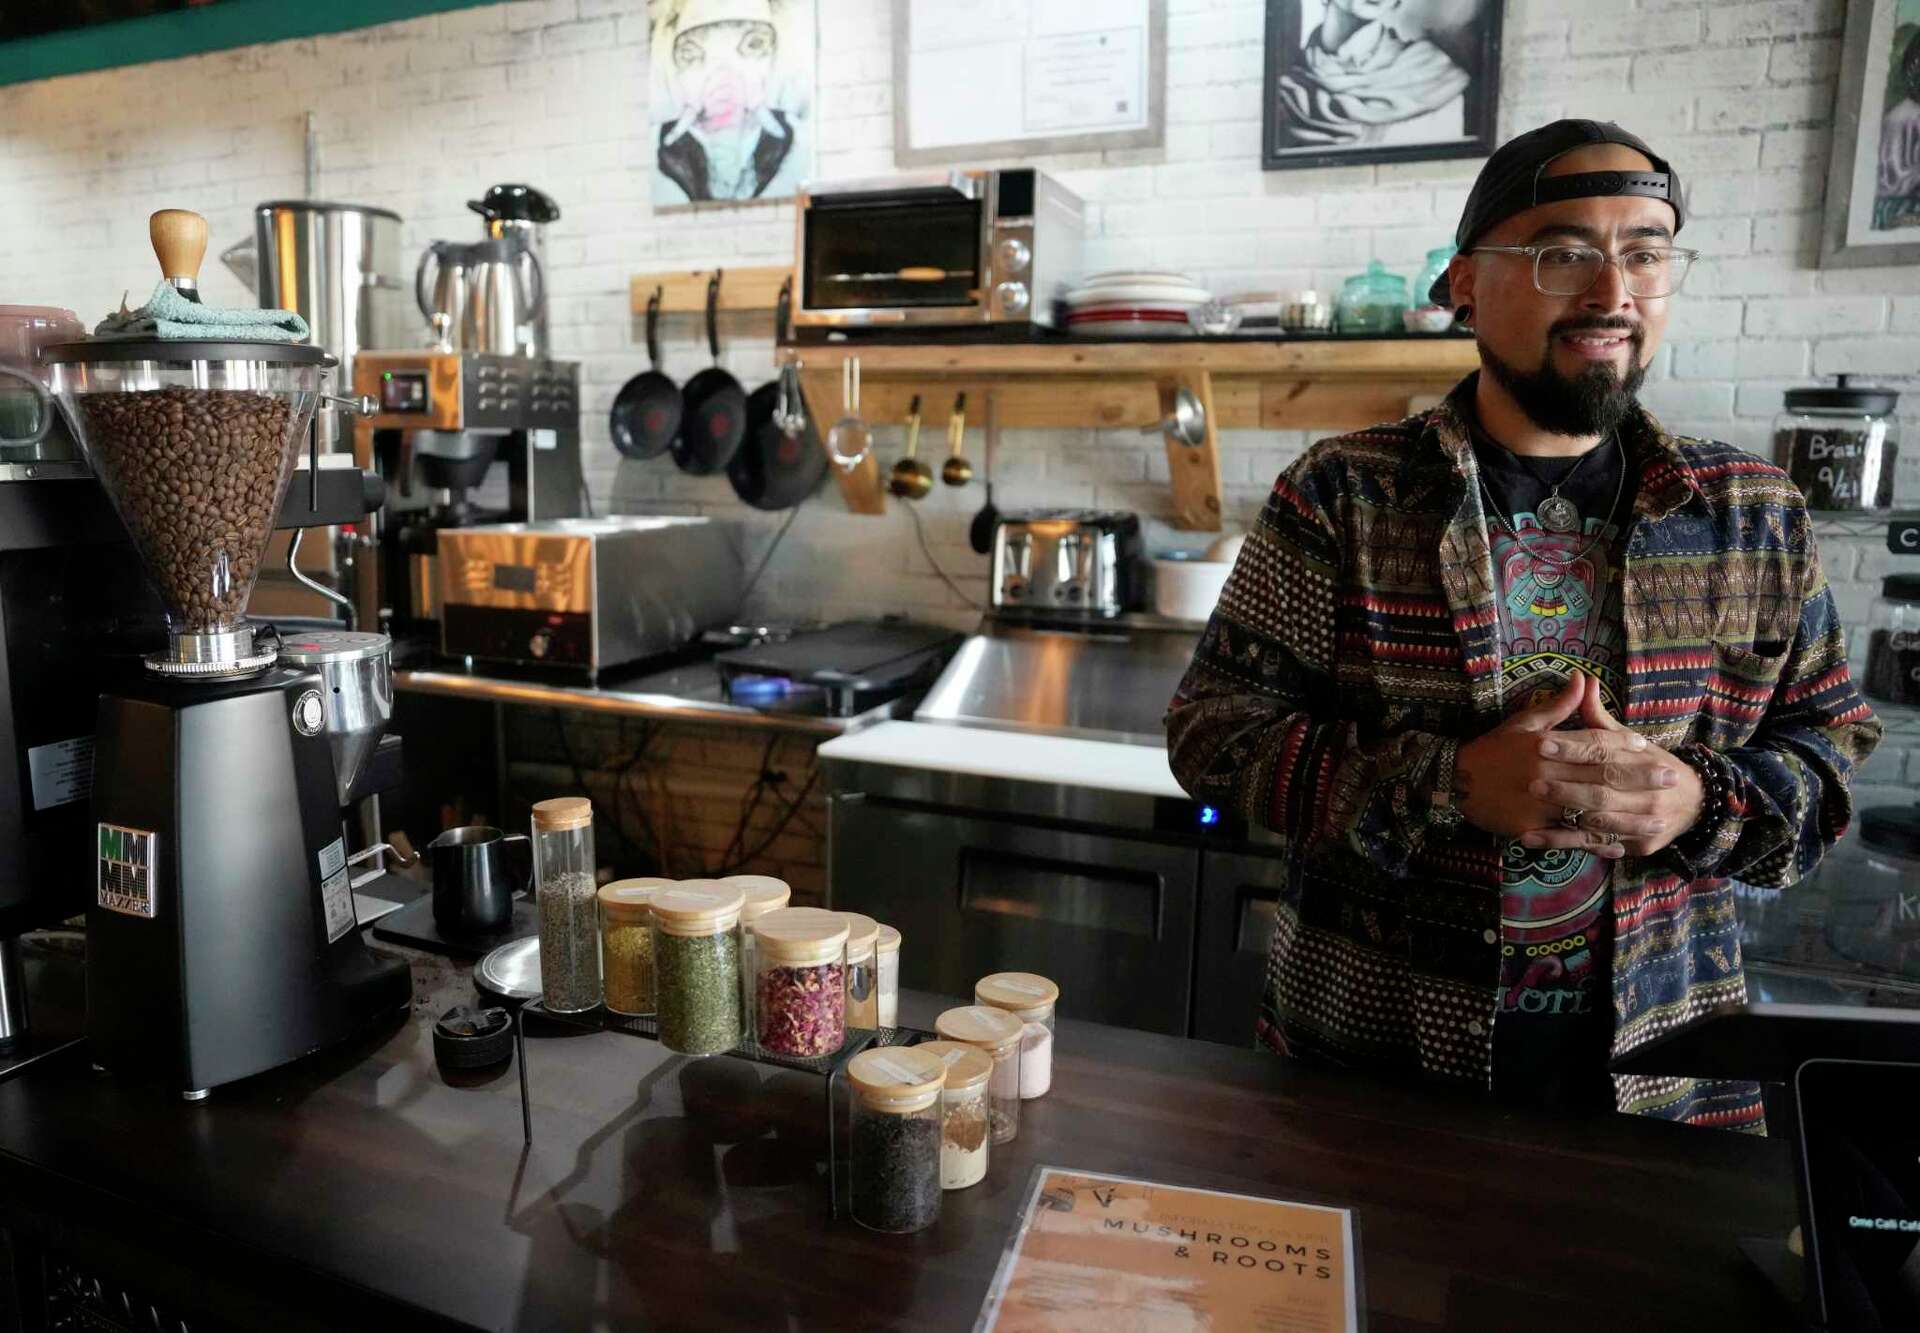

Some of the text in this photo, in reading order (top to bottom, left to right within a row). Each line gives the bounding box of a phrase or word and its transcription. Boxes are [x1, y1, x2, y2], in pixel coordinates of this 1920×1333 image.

[1818, 466, 1858, 498] 9/21
[1103, 1217, 1331, 1260] MUSHROOMS
[1174, 1246, 1331, 1279] & ROOTS
